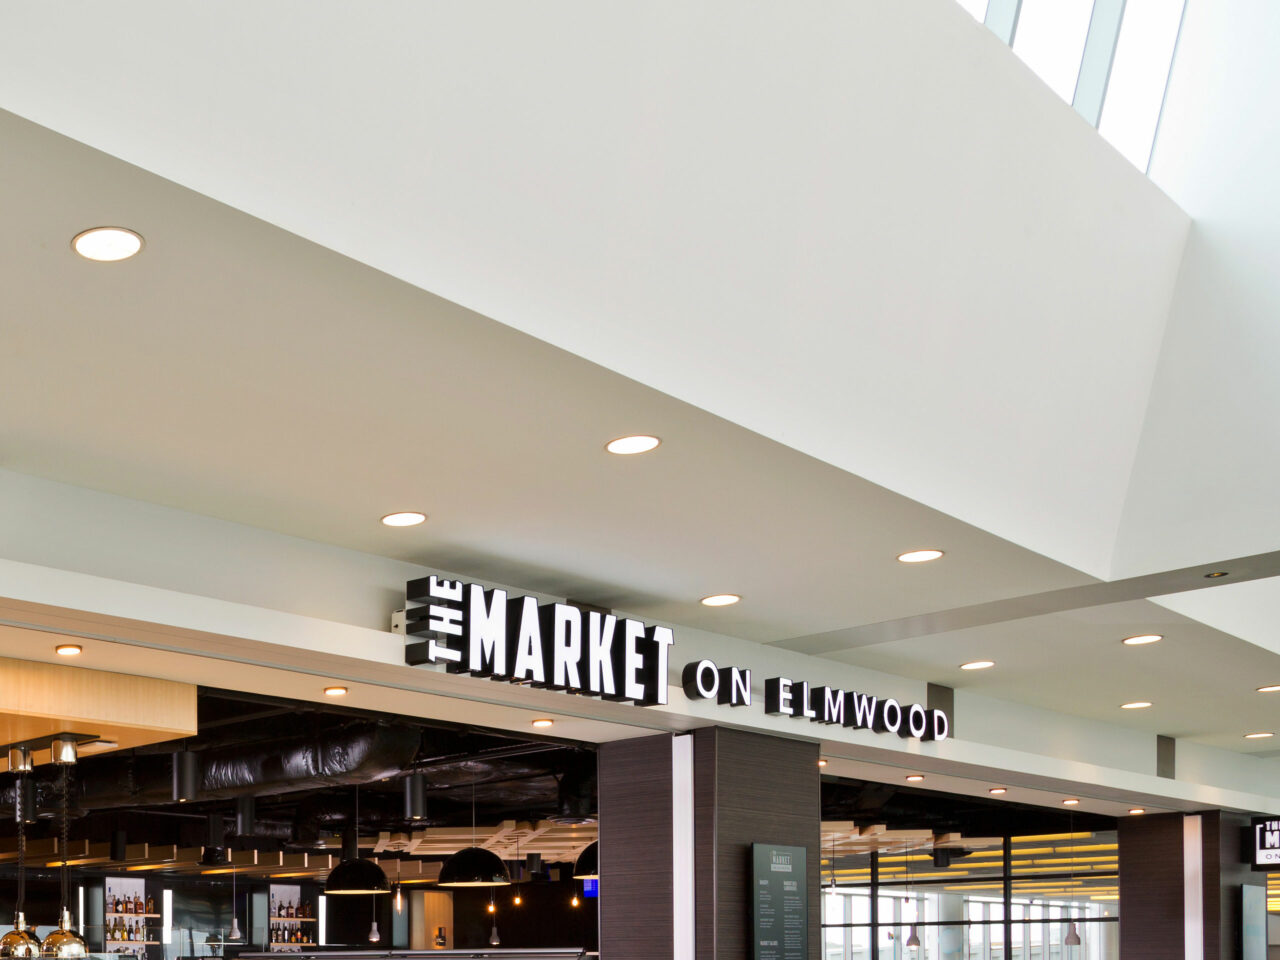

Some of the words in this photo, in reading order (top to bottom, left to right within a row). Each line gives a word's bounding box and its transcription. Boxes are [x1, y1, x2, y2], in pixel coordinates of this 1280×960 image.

[428, 575, 463, 663] THE
[469, 582, 675, 705] MARKET
[695, 659, 752, 706] ON
[778, 677, 949, 742] ELMWOOD
